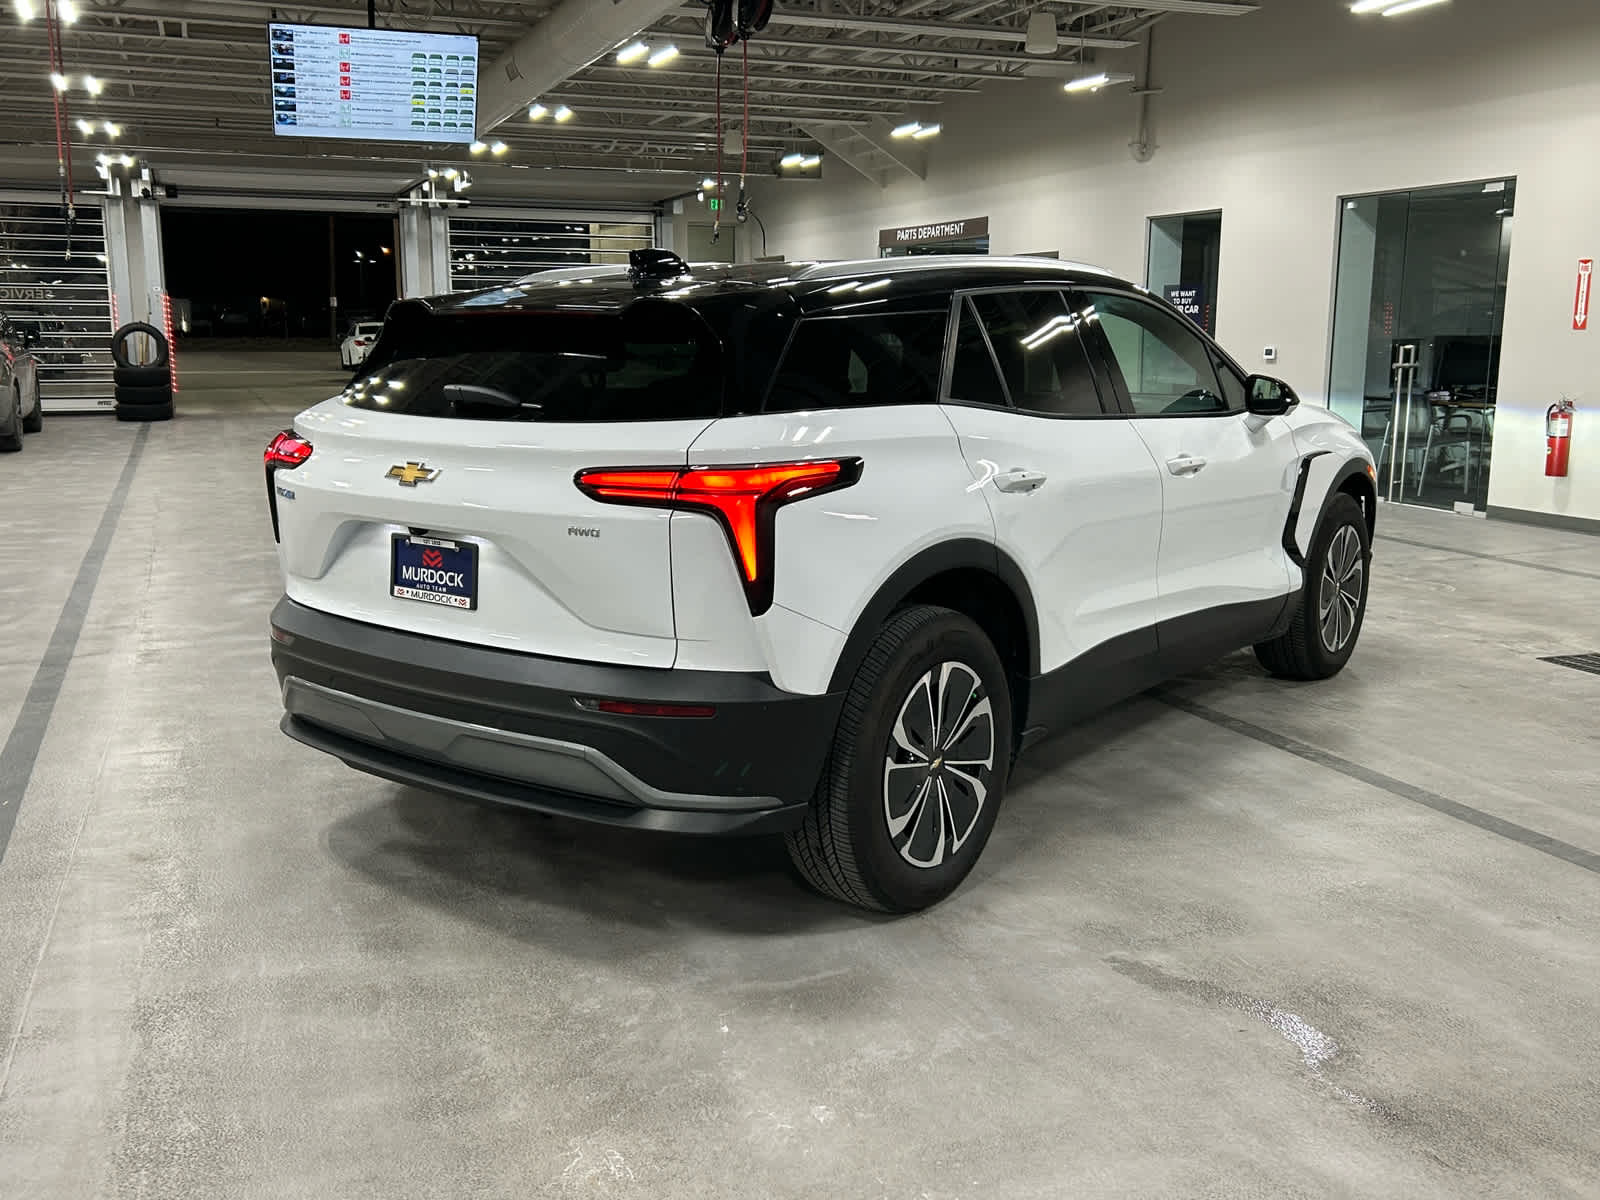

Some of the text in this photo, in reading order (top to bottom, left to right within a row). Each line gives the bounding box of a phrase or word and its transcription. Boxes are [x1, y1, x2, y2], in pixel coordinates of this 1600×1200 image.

[897, 223, 964, 240] PARTS DEPARTMENT
[1184, 305, 1199, 313] CAR
[402, 565, 463, 588] MURDOCK
[410, 590, 452, 604] MURDOCK
